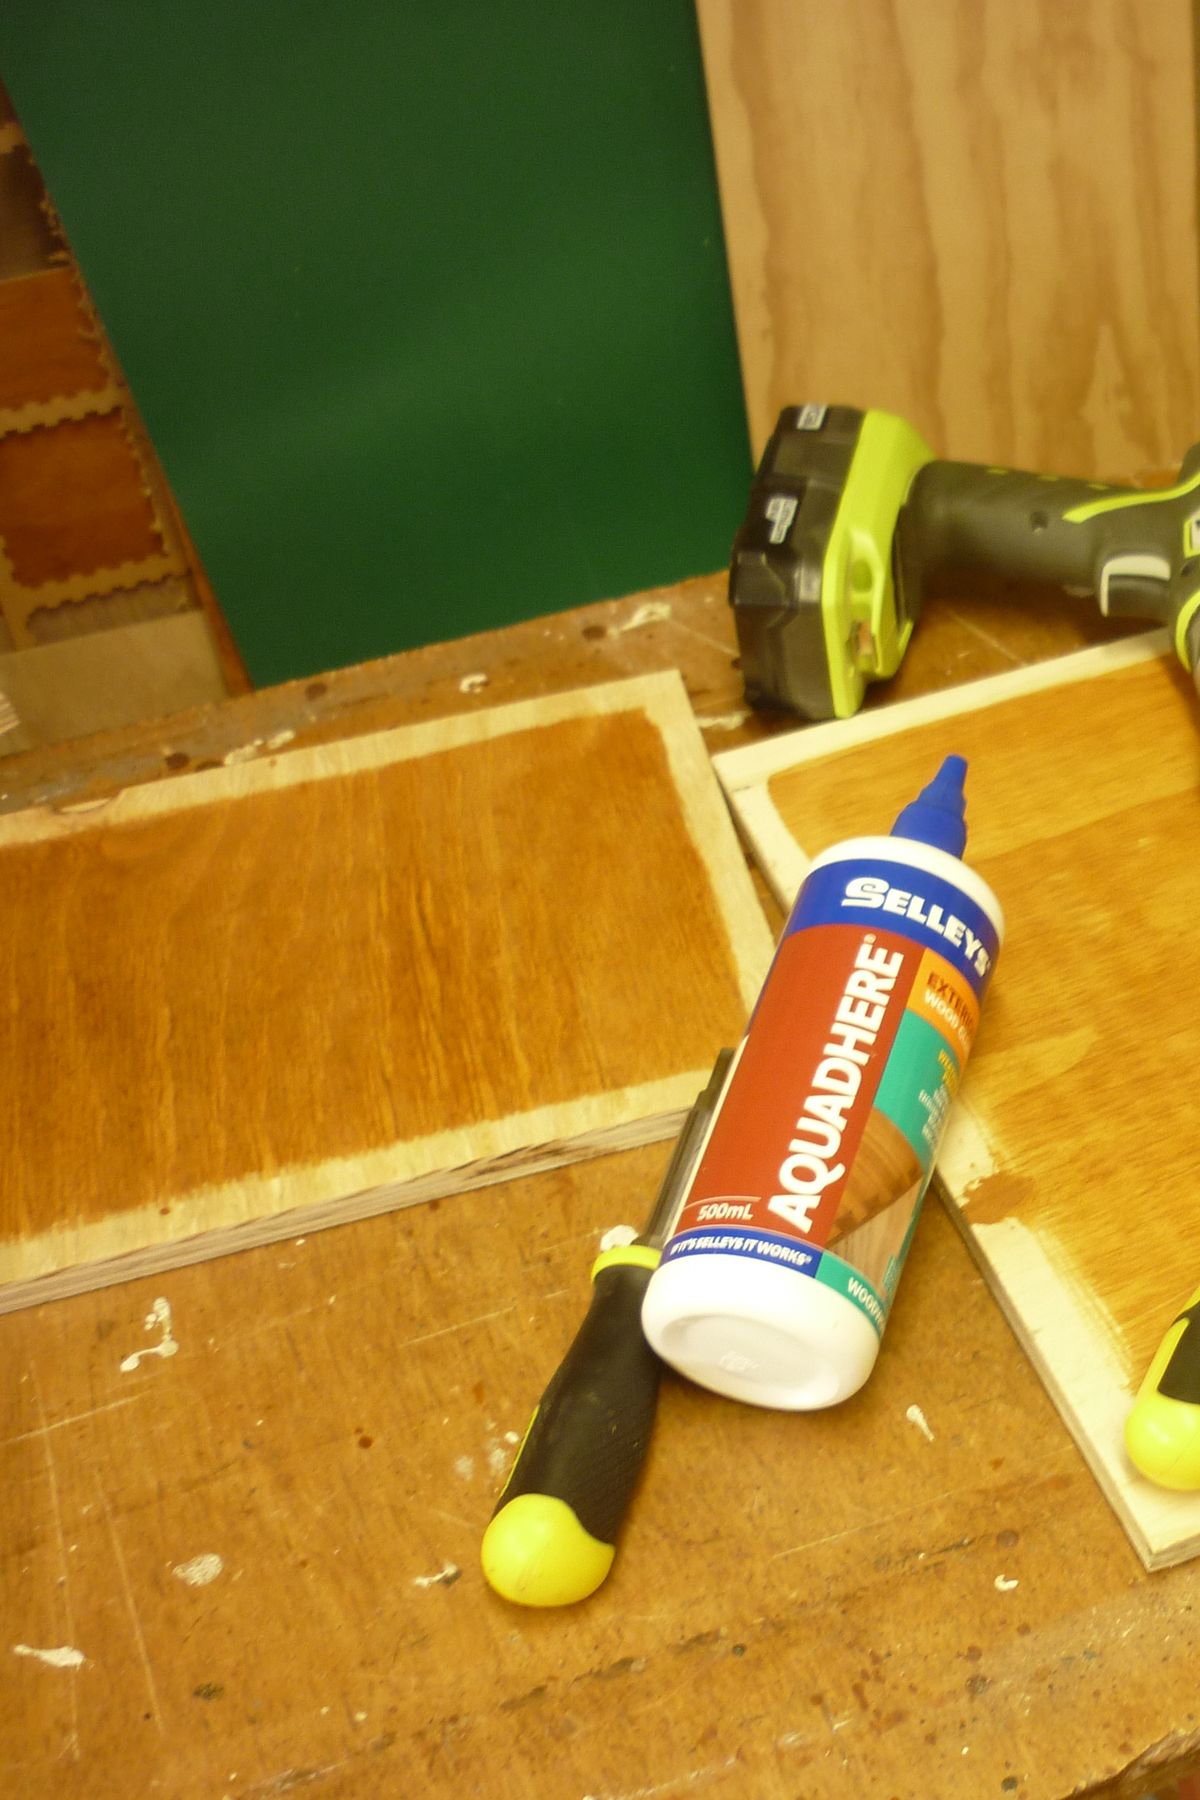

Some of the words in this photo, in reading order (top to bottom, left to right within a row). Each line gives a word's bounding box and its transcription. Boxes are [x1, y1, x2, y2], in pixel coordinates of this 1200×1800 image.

[841, 877, 987, 977] SELLEYS
[924, 988, 959, 1029] WOOD
[767, 940, 904, 1234] AQUADHERE
[697, 1203, 754, 1222] 500mL
[742, 1239, 758, 1252] IT
[757, 1241, 808, 1266] WORKS
